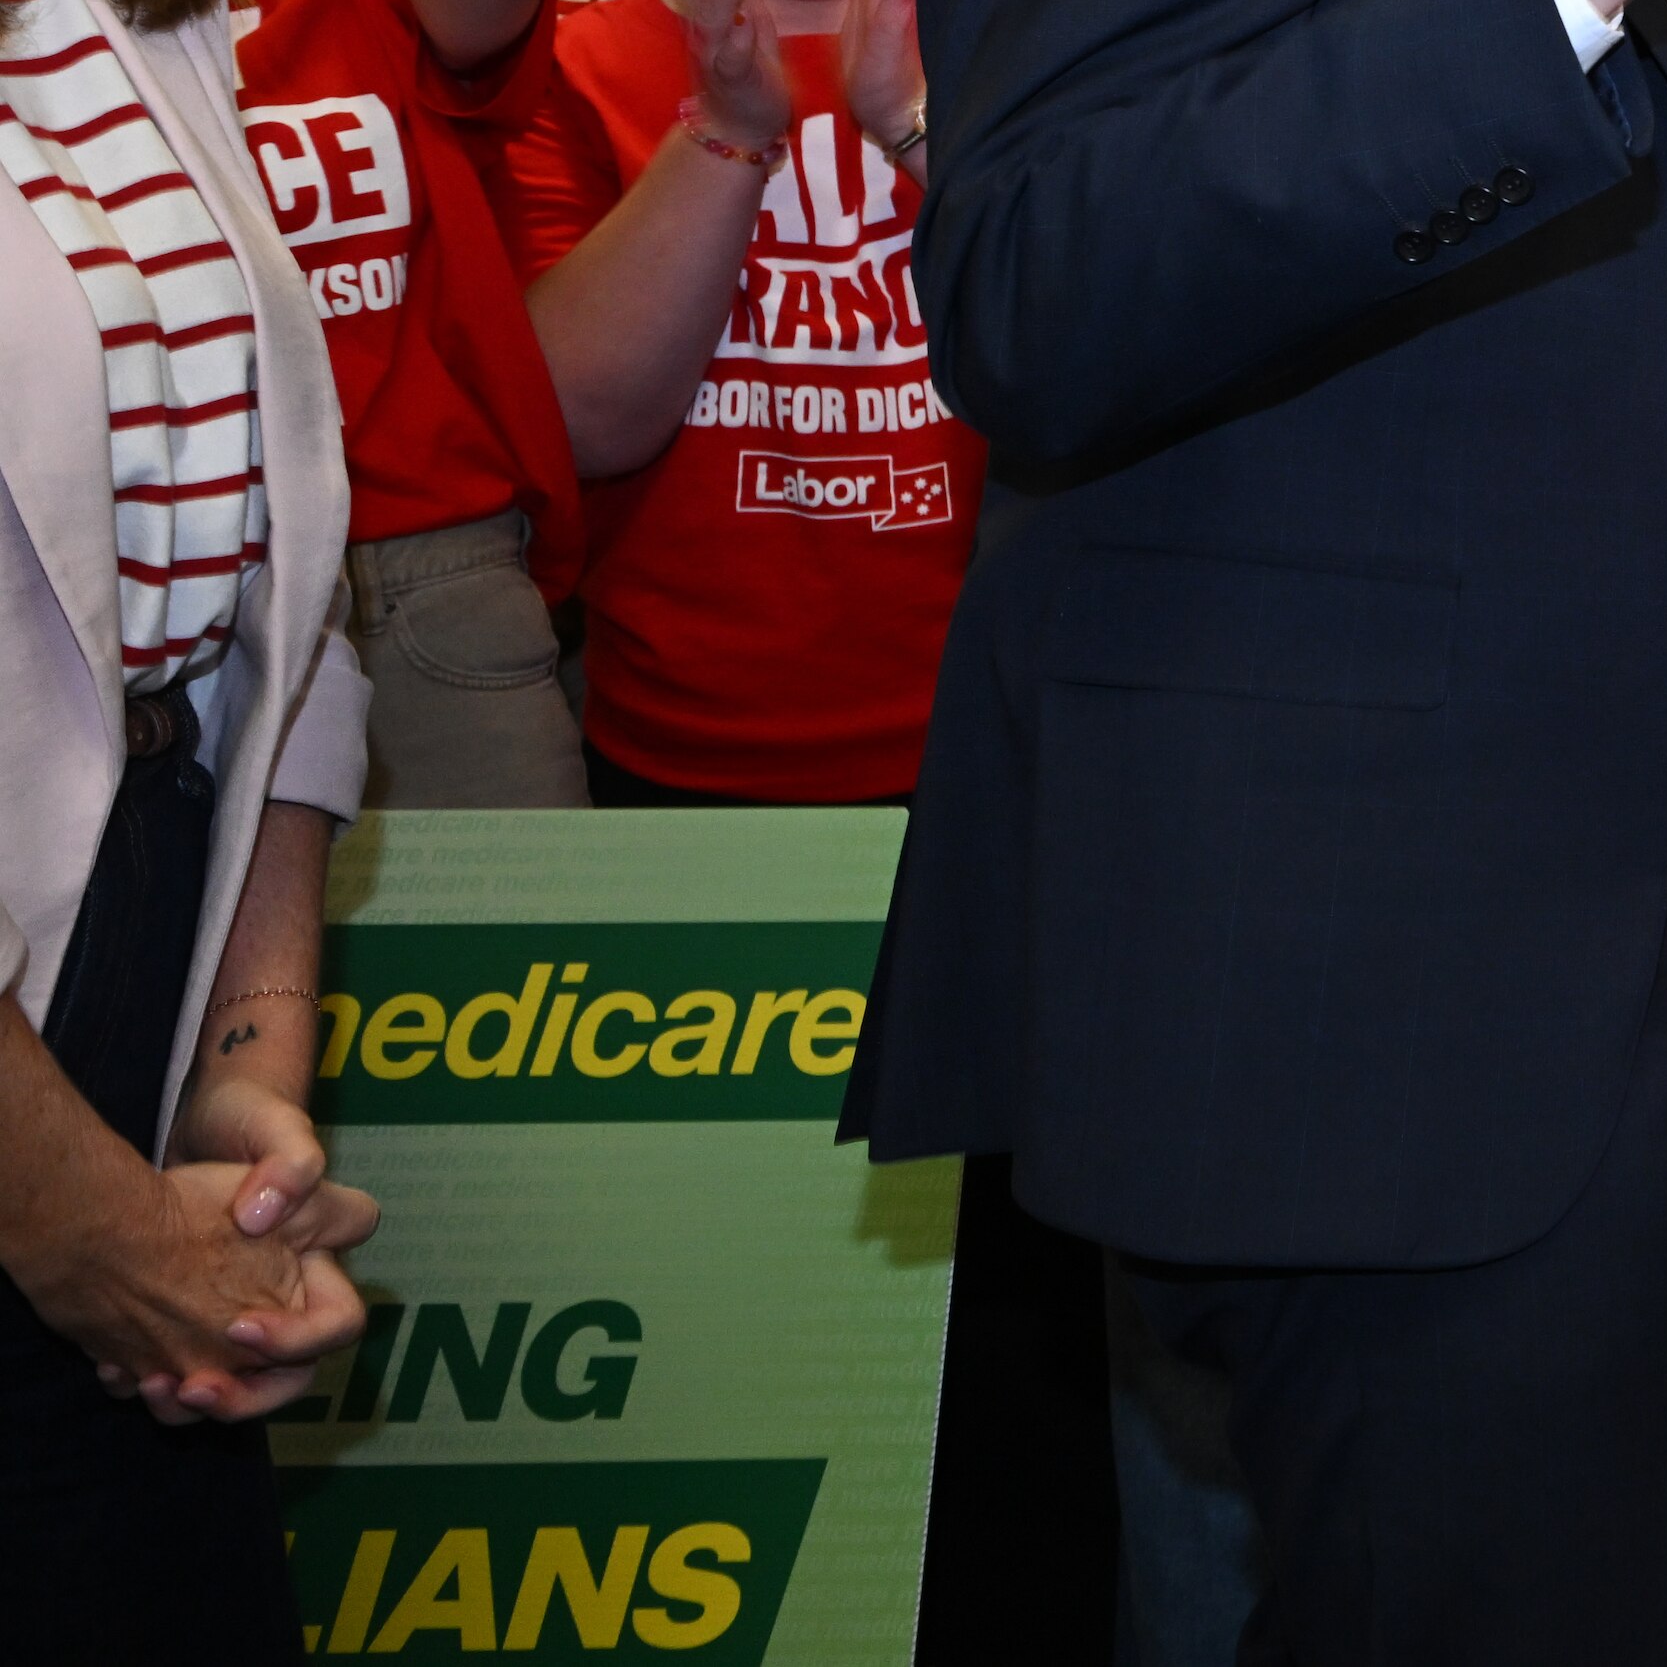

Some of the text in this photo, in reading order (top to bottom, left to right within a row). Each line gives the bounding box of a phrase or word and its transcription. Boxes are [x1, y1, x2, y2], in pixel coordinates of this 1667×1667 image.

[752, 112, 897, 248] ALI
[773, 385, 848, 434] FOR
[755, 462, 875, 509] Labor
